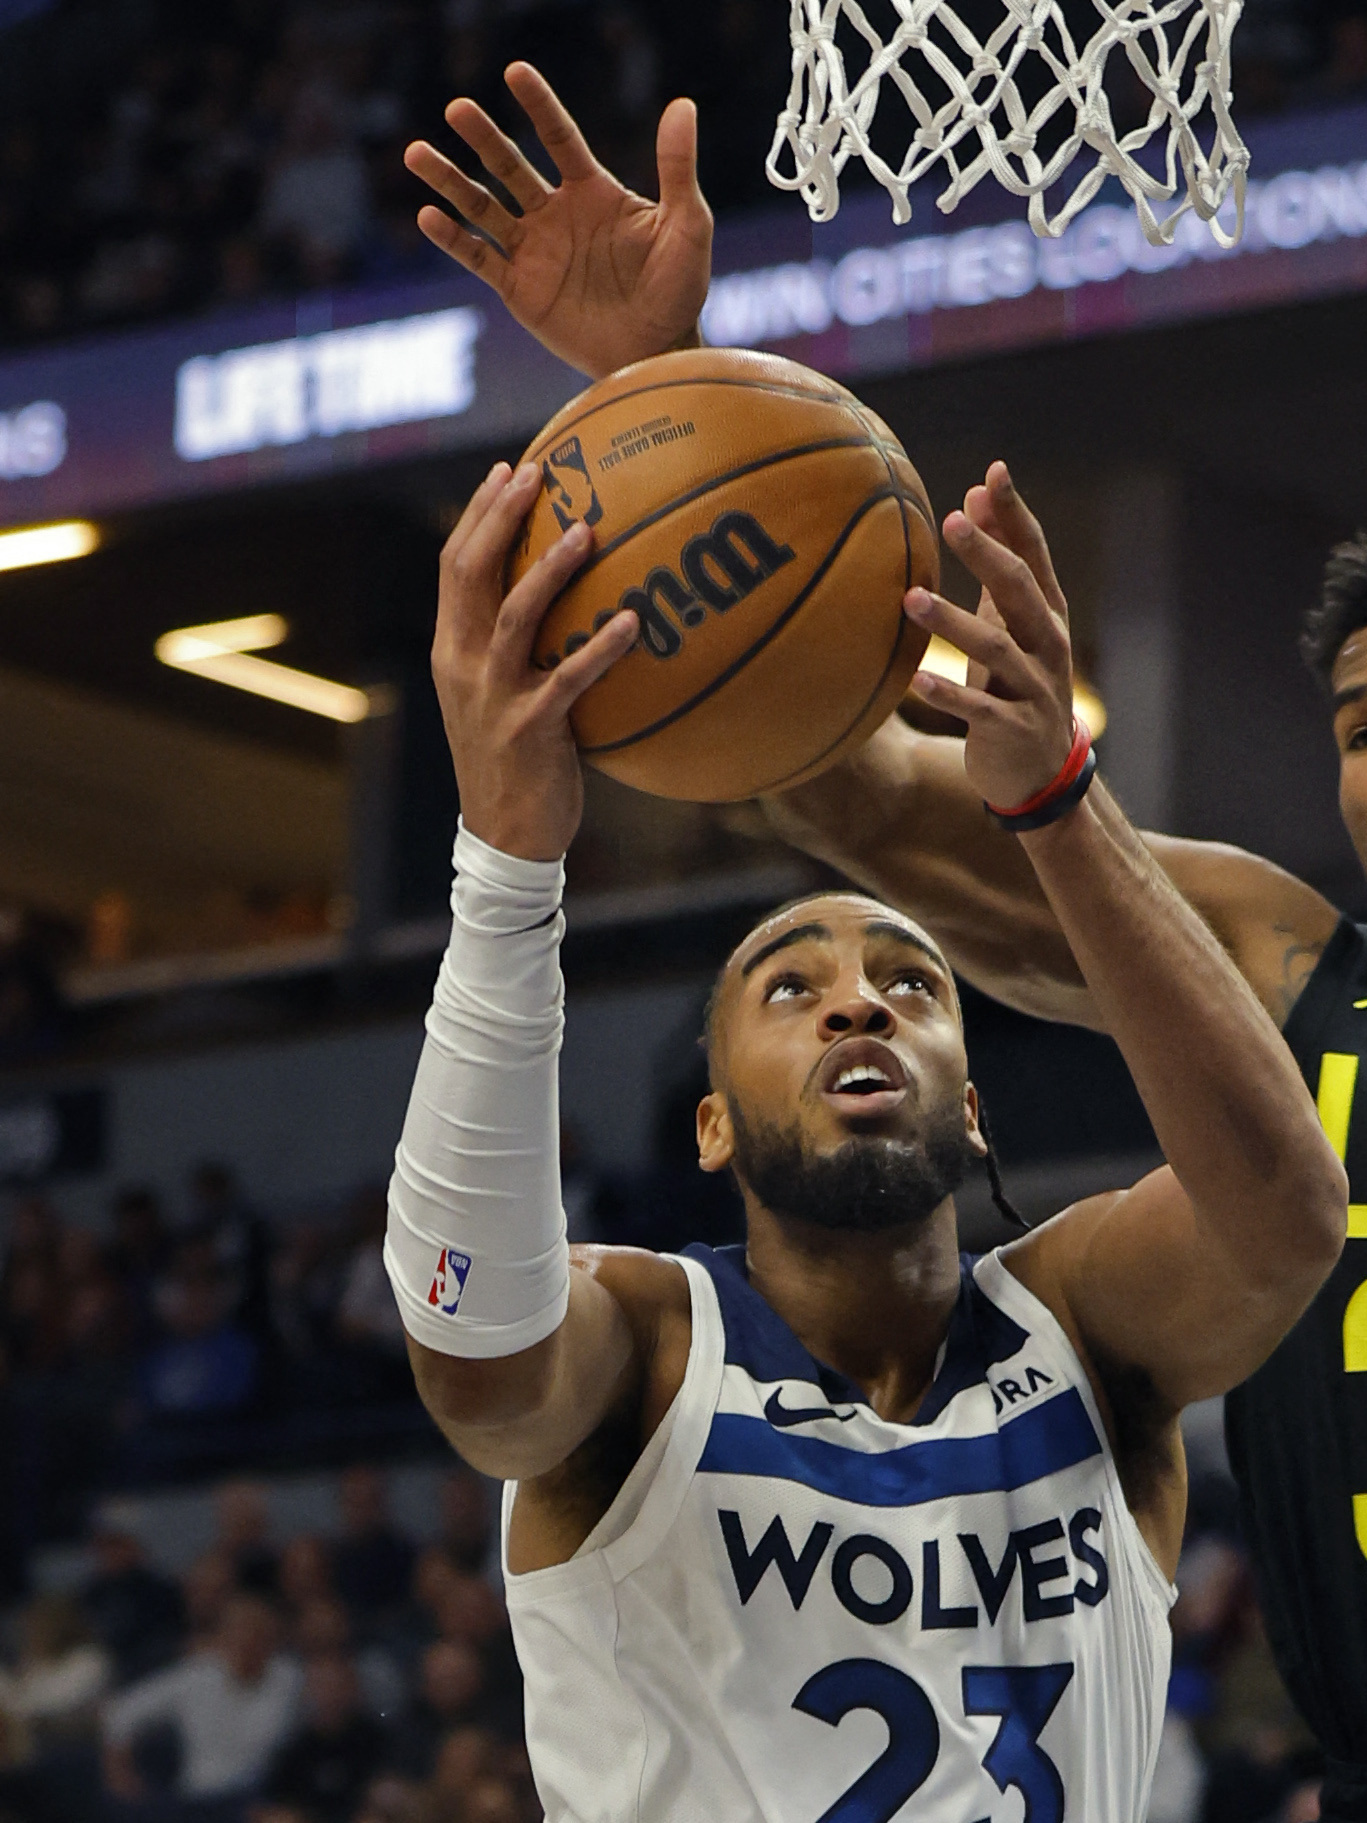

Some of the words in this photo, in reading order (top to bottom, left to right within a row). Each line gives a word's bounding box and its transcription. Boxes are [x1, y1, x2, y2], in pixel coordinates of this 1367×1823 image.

[623, 436, 651, 458] GAME
[652, 421, 695, 447] OFFICIAL
[540, 509, 796, 672] Wil
[450, 1253, 468, 1271] NBA
[717, 1507, 1109, 1631] WOLVES
[791, 1657, 1075, 1823] 23
